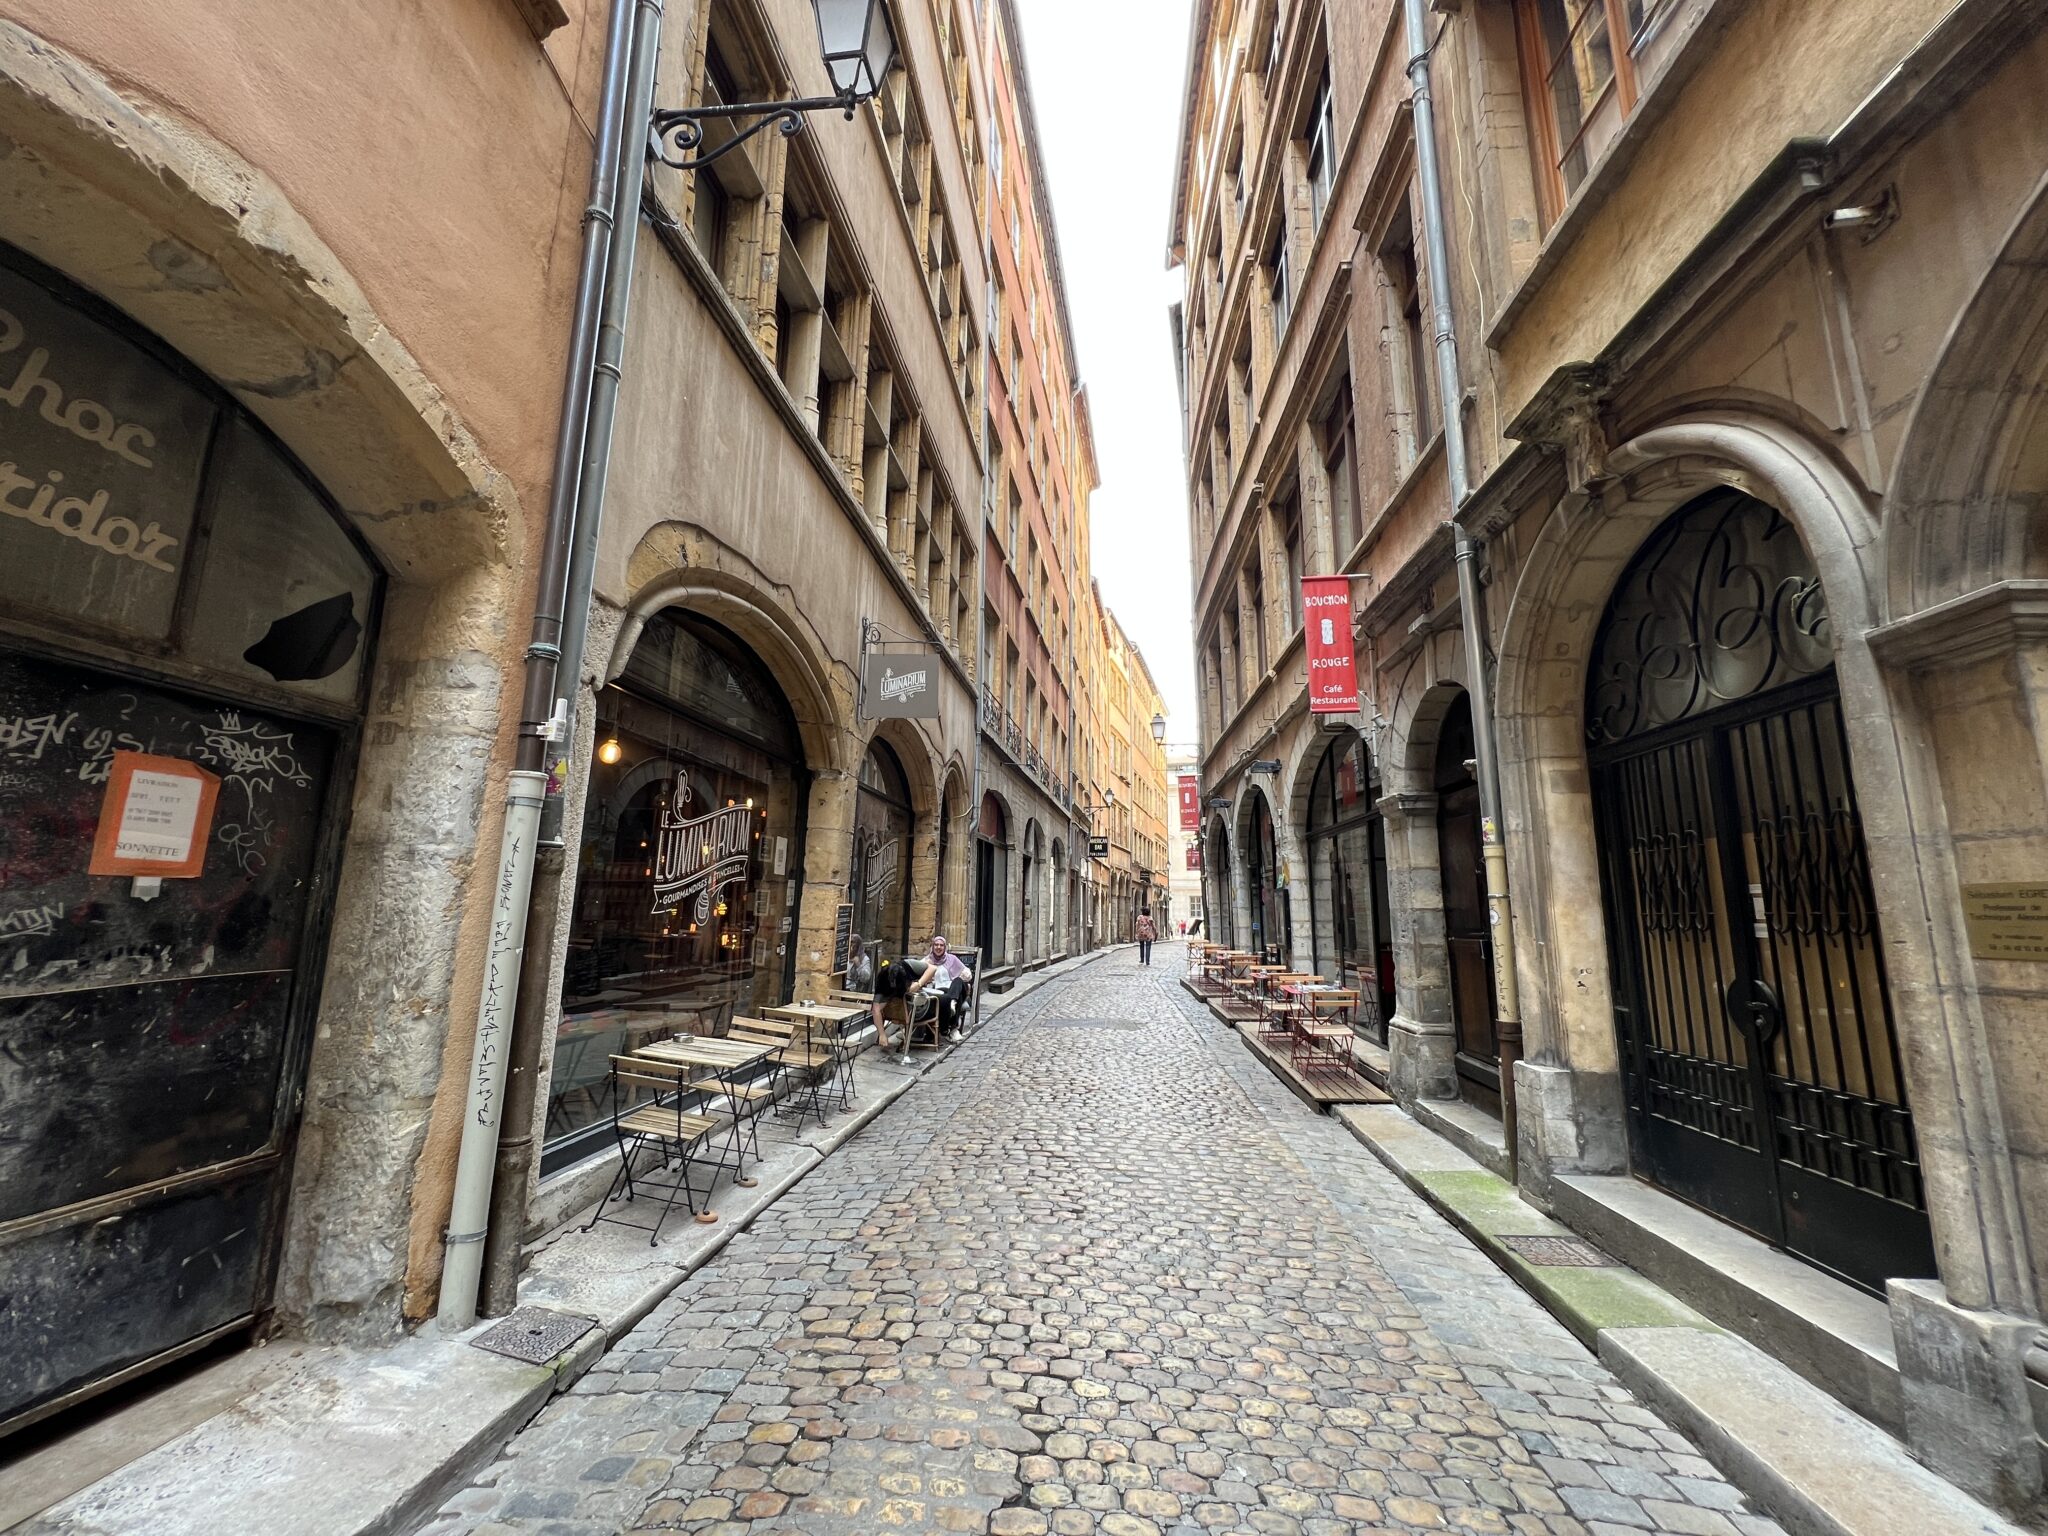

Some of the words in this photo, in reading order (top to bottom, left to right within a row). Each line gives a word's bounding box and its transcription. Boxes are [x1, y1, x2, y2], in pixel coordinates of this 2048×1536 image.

[1305, 594, 1348, 607] BOUCHON
[1312, 657, 1349, 668] ROUGE
[881, 671, 926, 693] LUMINARIUM
[1323, 684, 1343, 693] Café
[1311, 696, 1357, 705] Restaurant
[661, 810, 671, 828] LE
[116, 841, 181, 857] SONNETTE
[655, 811, 750, 880] LUMINARIUM
[663, 879, 708, 905] GOURMANDISES
